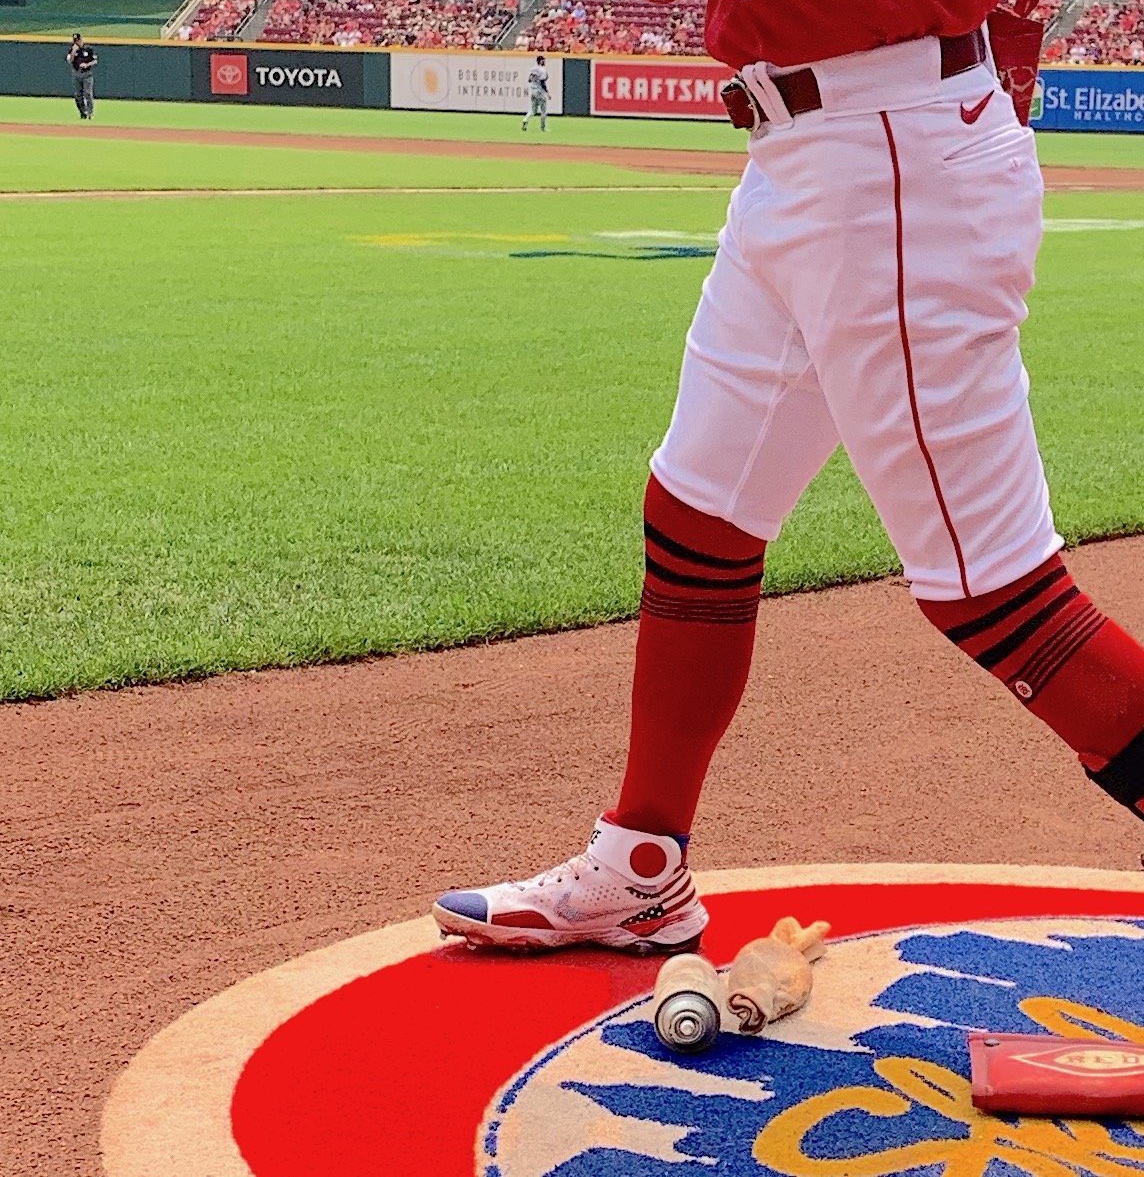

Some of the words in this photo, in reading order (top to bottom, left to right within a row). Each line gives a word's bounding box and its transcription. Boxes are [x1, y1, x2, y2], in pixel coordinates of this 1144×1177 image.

[255, 65, 342, 89] TOYOTA
[483, 70, 519, 82] GROUP
[1046, 86, 1071, 109] St.
